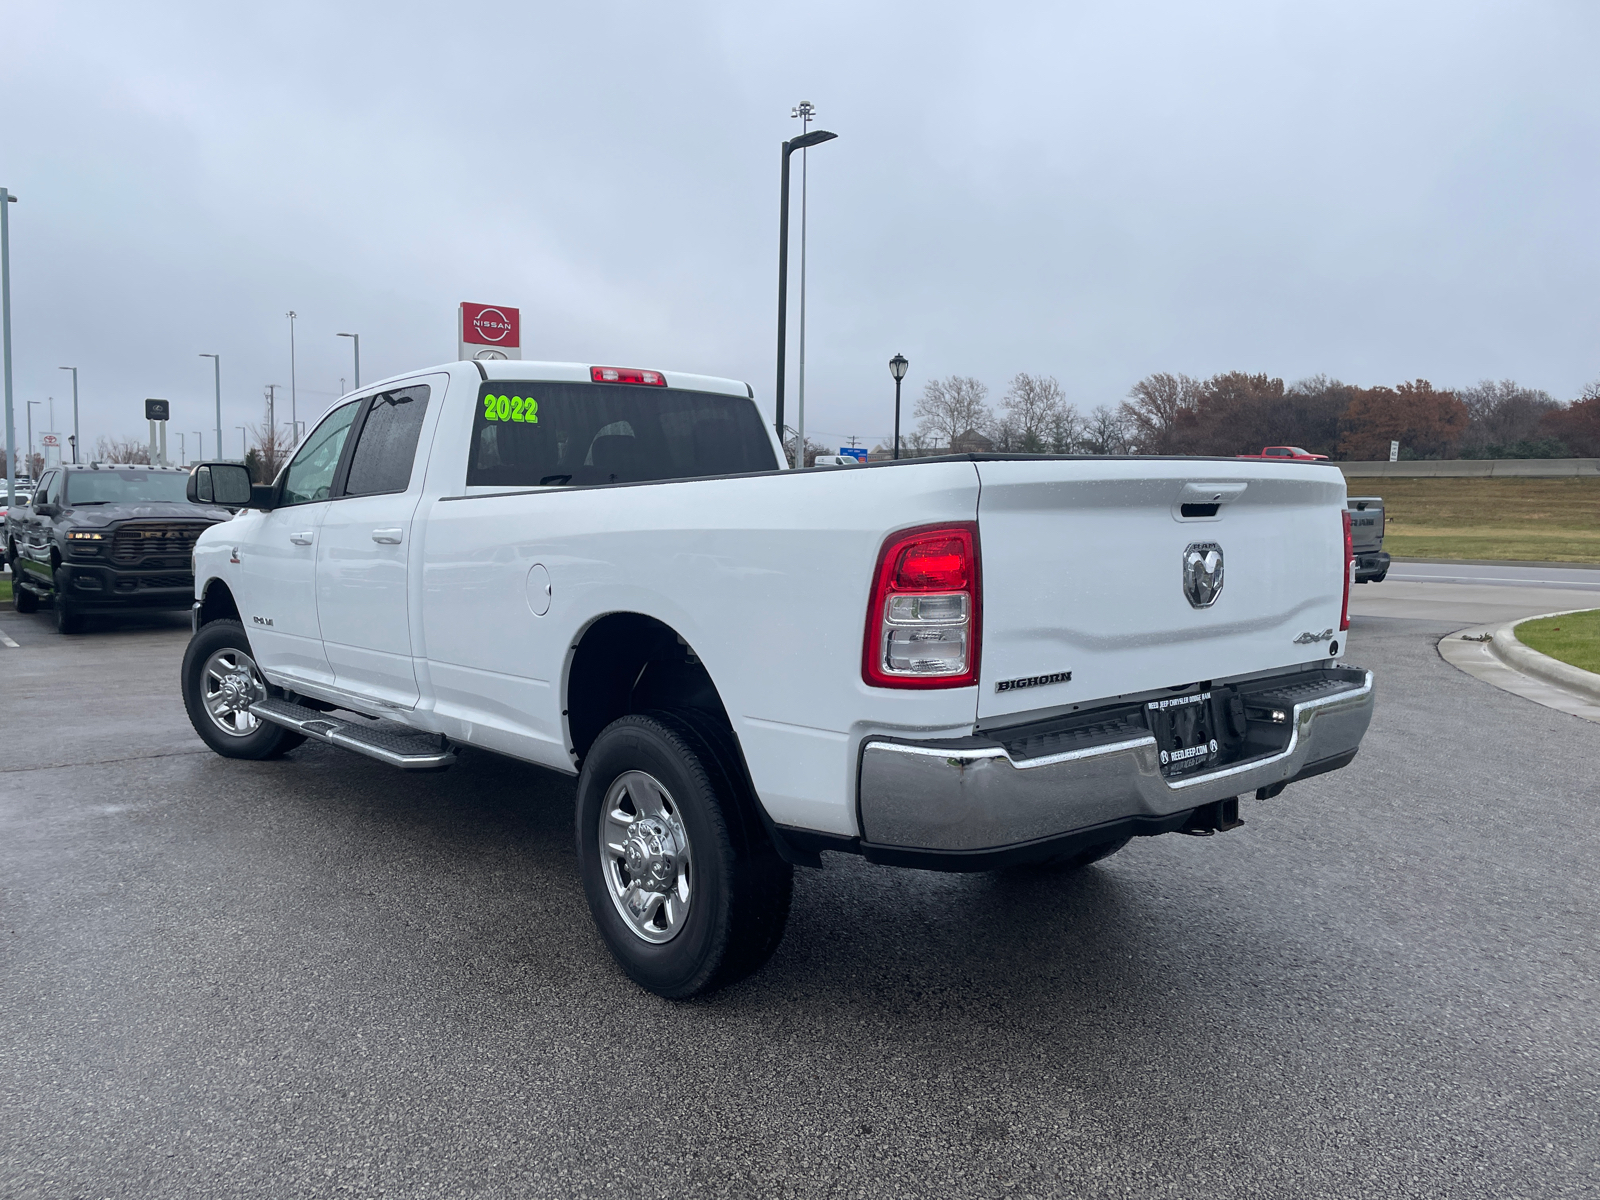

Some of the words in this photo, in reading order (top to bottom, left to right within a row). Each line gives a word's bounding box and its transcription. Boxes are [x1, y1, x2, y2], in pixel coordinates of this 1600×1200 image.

[473, 319, 511, 330] NISSAN
[484, 394, 538, 424] 2022
[1351, 518, 1375, 526] RAM
[996, 671, 1073, 693] BIGHORN
[1159, 700, 1169, 708] JEEP
[1170, 697, 1189, 706] CHRYSLER
[1202, 692, 1211, 700] RAM
[1171, 745, 1208, 761] REEDJEEP.COM
